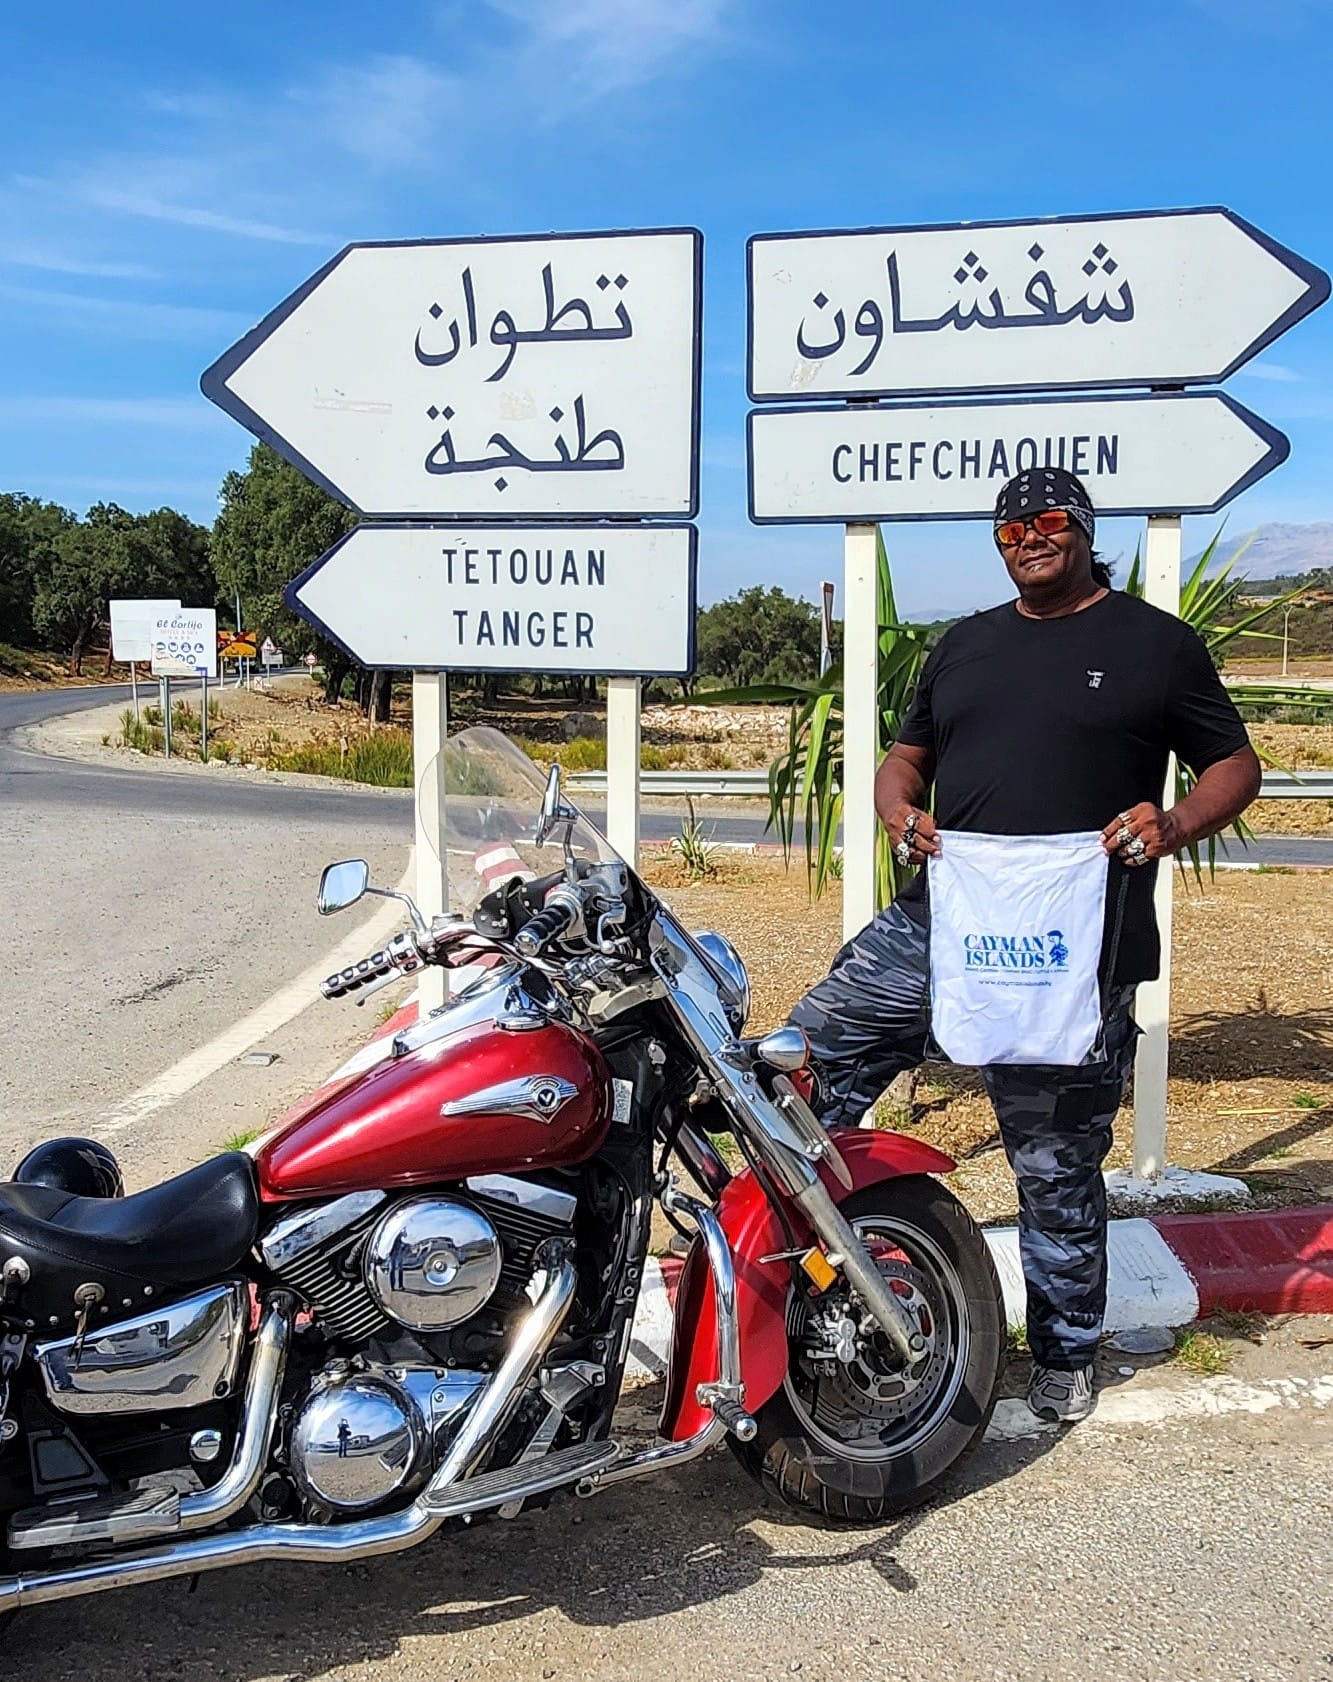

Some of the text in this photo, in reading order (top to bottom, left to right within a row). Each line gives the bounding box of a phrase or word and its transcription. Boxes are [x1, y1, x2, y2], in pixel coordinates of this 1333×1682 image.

[414, 261, 633, 382] تطوان
[796, 242, 1135, 376] شفشاون
[425, 393, 625, 492] طنجة
[832, 435, 1119, 483] CHEFCHAOUEN
[442, 548, 606, 586] TETOUAN
[453, 610, 595, 649] TANGER
[964, 934, 1045, 952] CAYMAN
[966, 950, 1045, 967] ISLANDS
